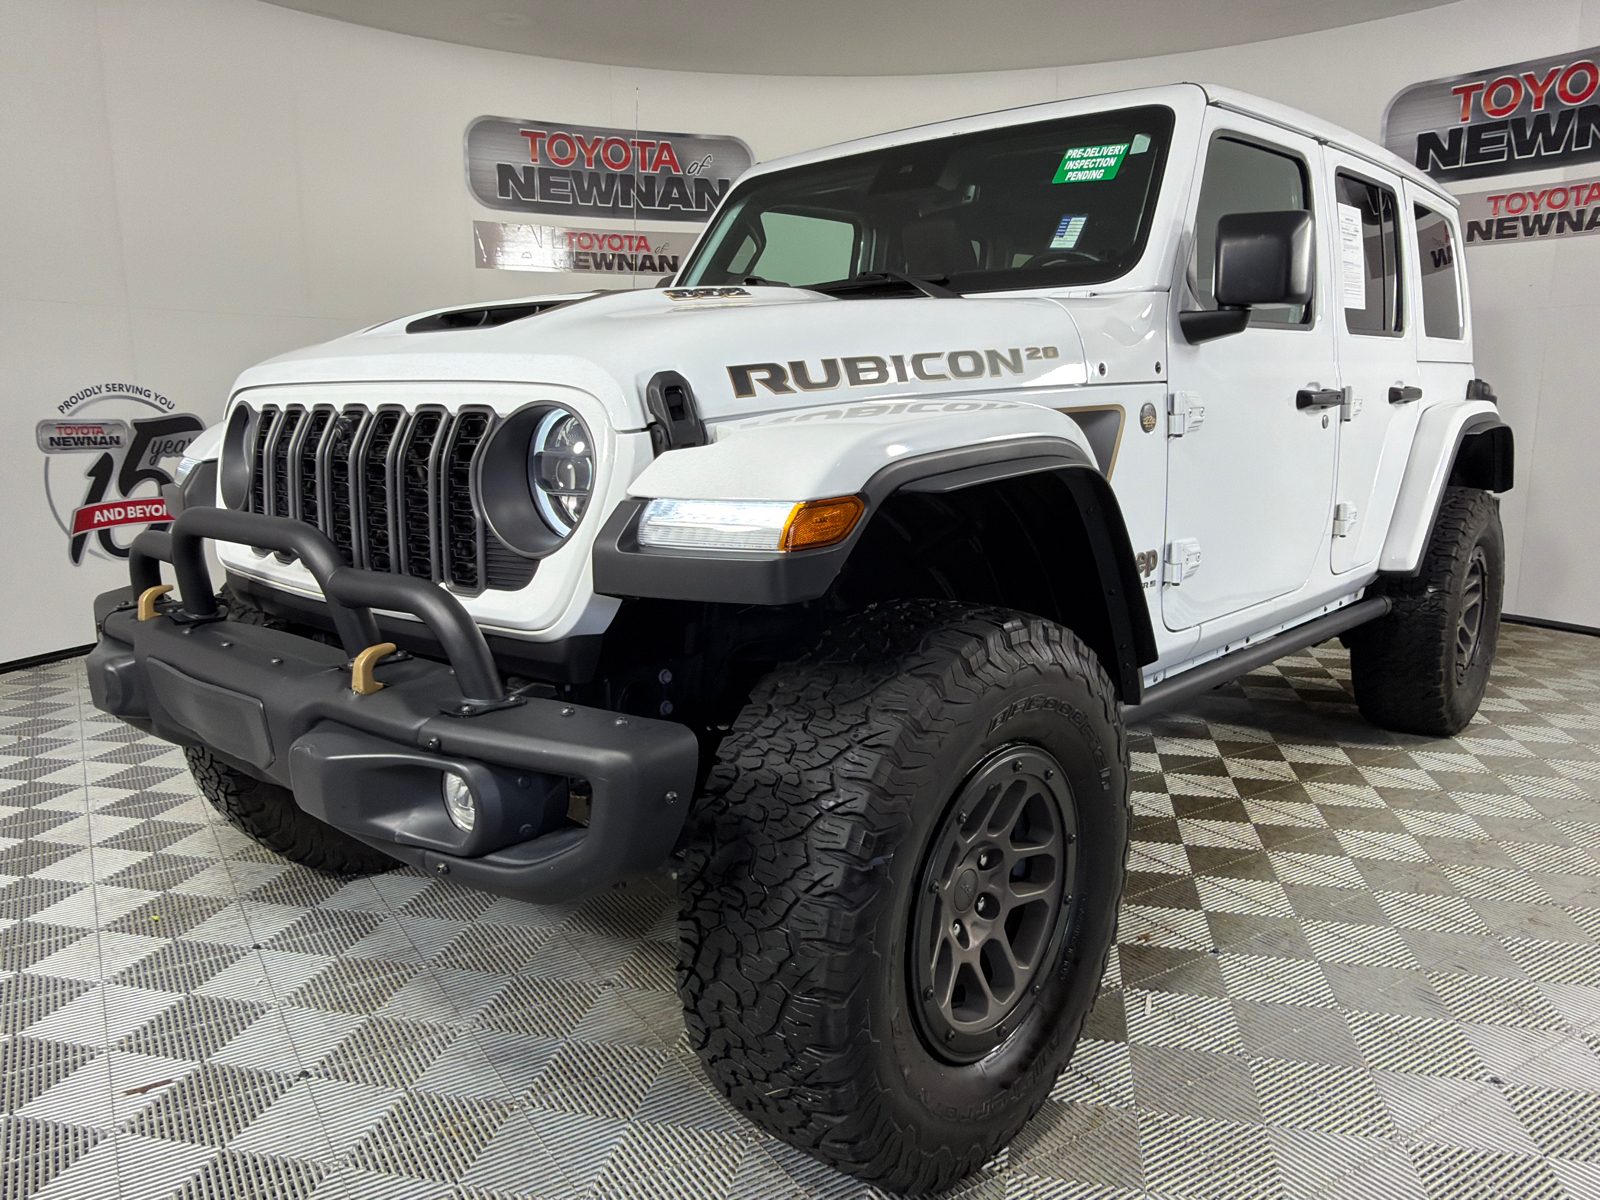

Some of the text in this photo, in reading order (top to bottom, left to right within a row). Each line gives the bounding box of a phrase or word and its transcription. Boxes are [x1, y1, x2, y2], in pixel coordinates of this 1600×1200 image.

[1451, 59, 1600, 125] TOYO
[1415, 103, 1600, 172] NEWN
[519, 128, 713, 176] TOYOTA of
[1064, 157, 1117, 171] INSPECTION
[1065, 144, 1127, 160] PRE-DELIVERY
[496, 163, 731, 211] NEWNAN
[1065, 169, 1105, 181] PENDING
[563, 231, 652, 253] TOYOTA
[556, 250, 679, 274] EWNAN
[726, 346, 1060, 399] RUBICON 20
[57, 383, 175, 414] PROUDLY SERVING YOU
[49, 436, 121, 447] NEWNAN
[55, 426, 105, 436] TOYOTA
[149, 438, 192, 466] yea
[93, 504, 167, 524] AND BEYO
[1135, 549, 1158, 578] ep
